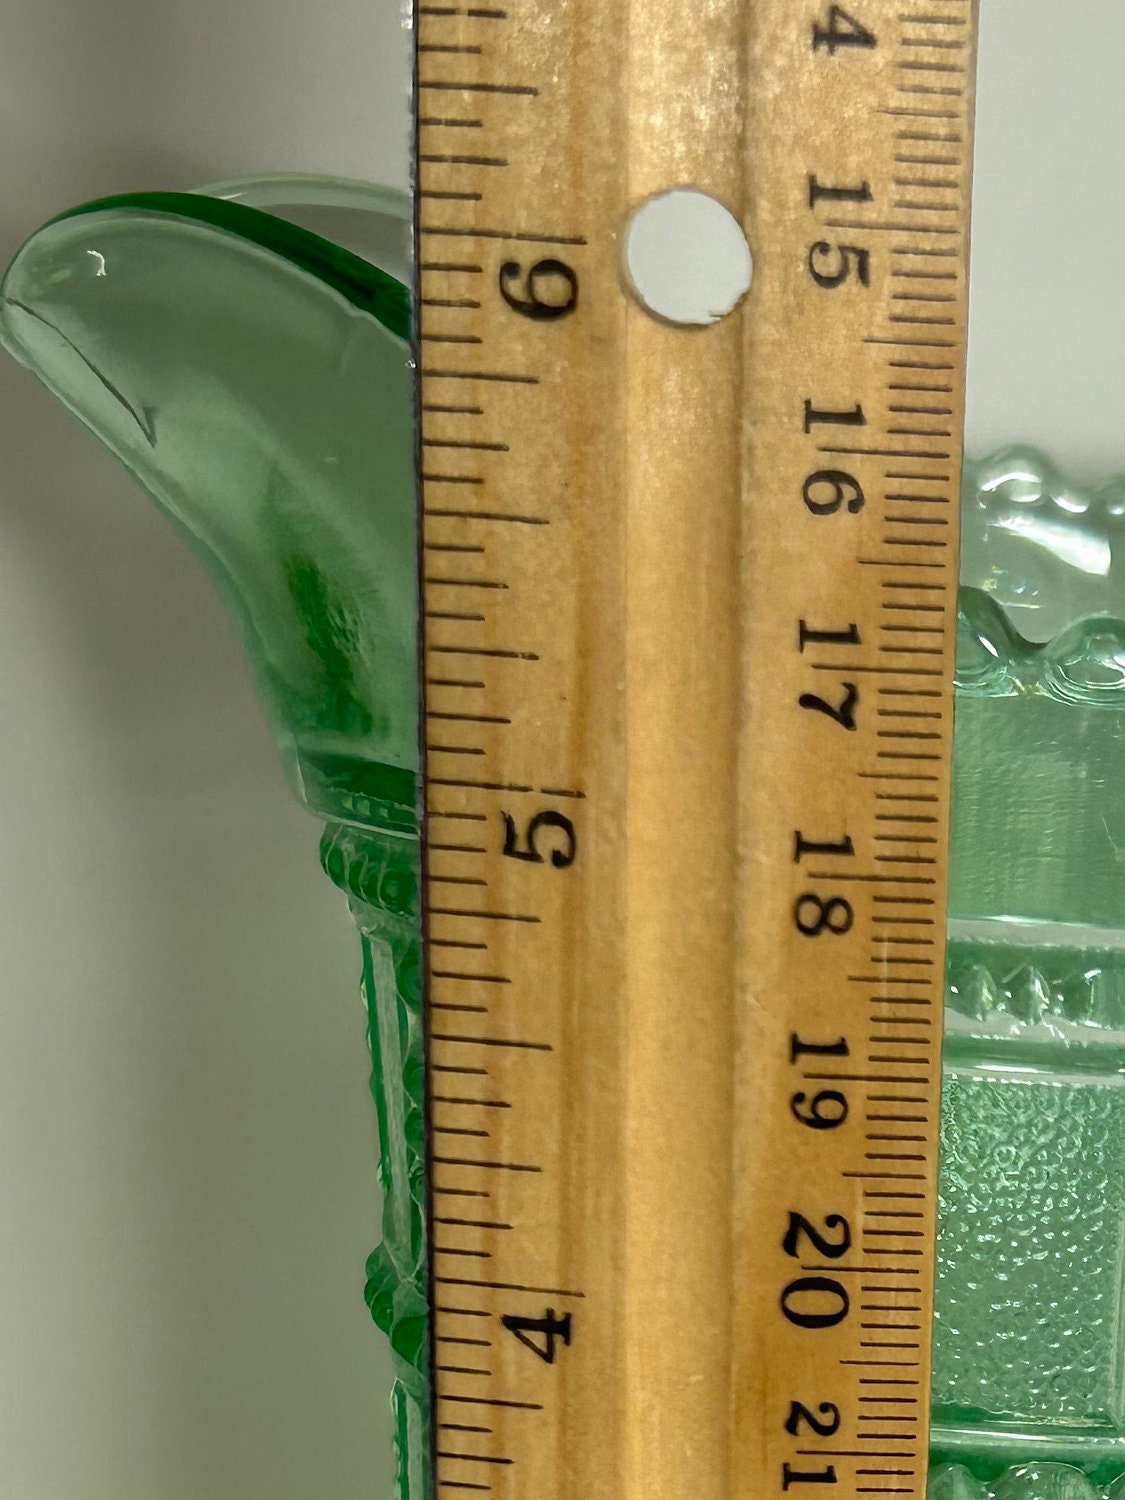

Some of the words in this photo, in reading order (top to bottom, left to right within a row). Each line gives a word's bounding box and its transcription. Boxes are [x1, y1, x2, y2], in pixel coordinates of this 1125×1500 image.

[808, 173, 872, 289] 15
[499, 258, 578, 321] 6
[802, 398, 867, 516] 16
[798, 618, 862, 731] 17
[501, 809, 577, 869] 5
[793, 829, 855, 937] 18
[790, 1032, 850, 1130] 19
[781, 1211, 851, 1329] 20
[501, 1307, 573, 1364] 4
[783, 1401, 841, 1491] 21
